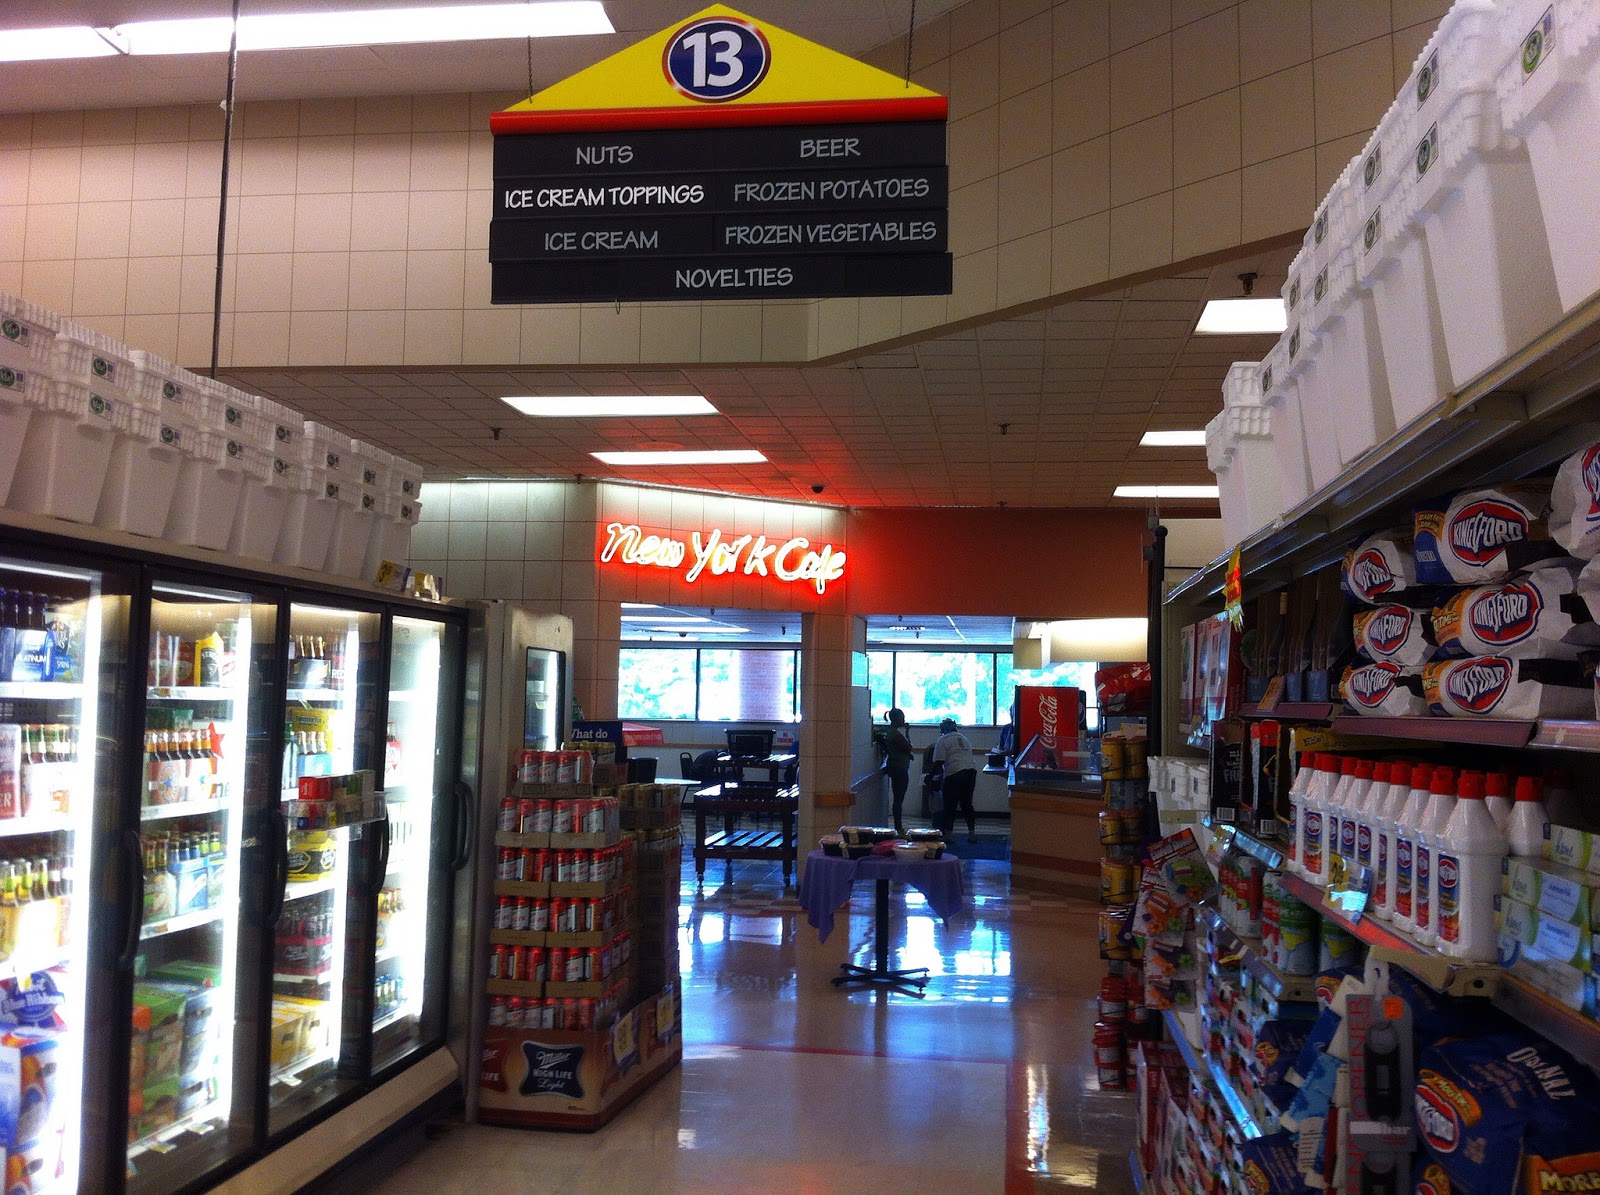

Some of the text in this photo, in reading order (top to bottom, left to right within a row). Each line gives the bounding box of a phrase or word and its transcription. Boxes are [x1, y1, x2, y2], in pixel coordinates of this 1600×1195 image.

[682, 31, 744, 87] 13
[576, 146, 634, 165] NUTS
[800, 138, 861, 158] BEER
[505, 185, 705, 209] ICE CREAM TOPPINGS
[734, 178, 930, 203] FROZEN POTATOES
[544, 230, 659, 251] ICE CREAM
[725, 221, 937, 246] FROZEN VEGETABLES
[675, 268, 793, 289] NOVELTIES
[600, 522, 685, 569] New
[685, 528, 777, 583] York
[595, 728, 608, 739] do
[532, 1070, 573, 1080] HIGH LIFE
